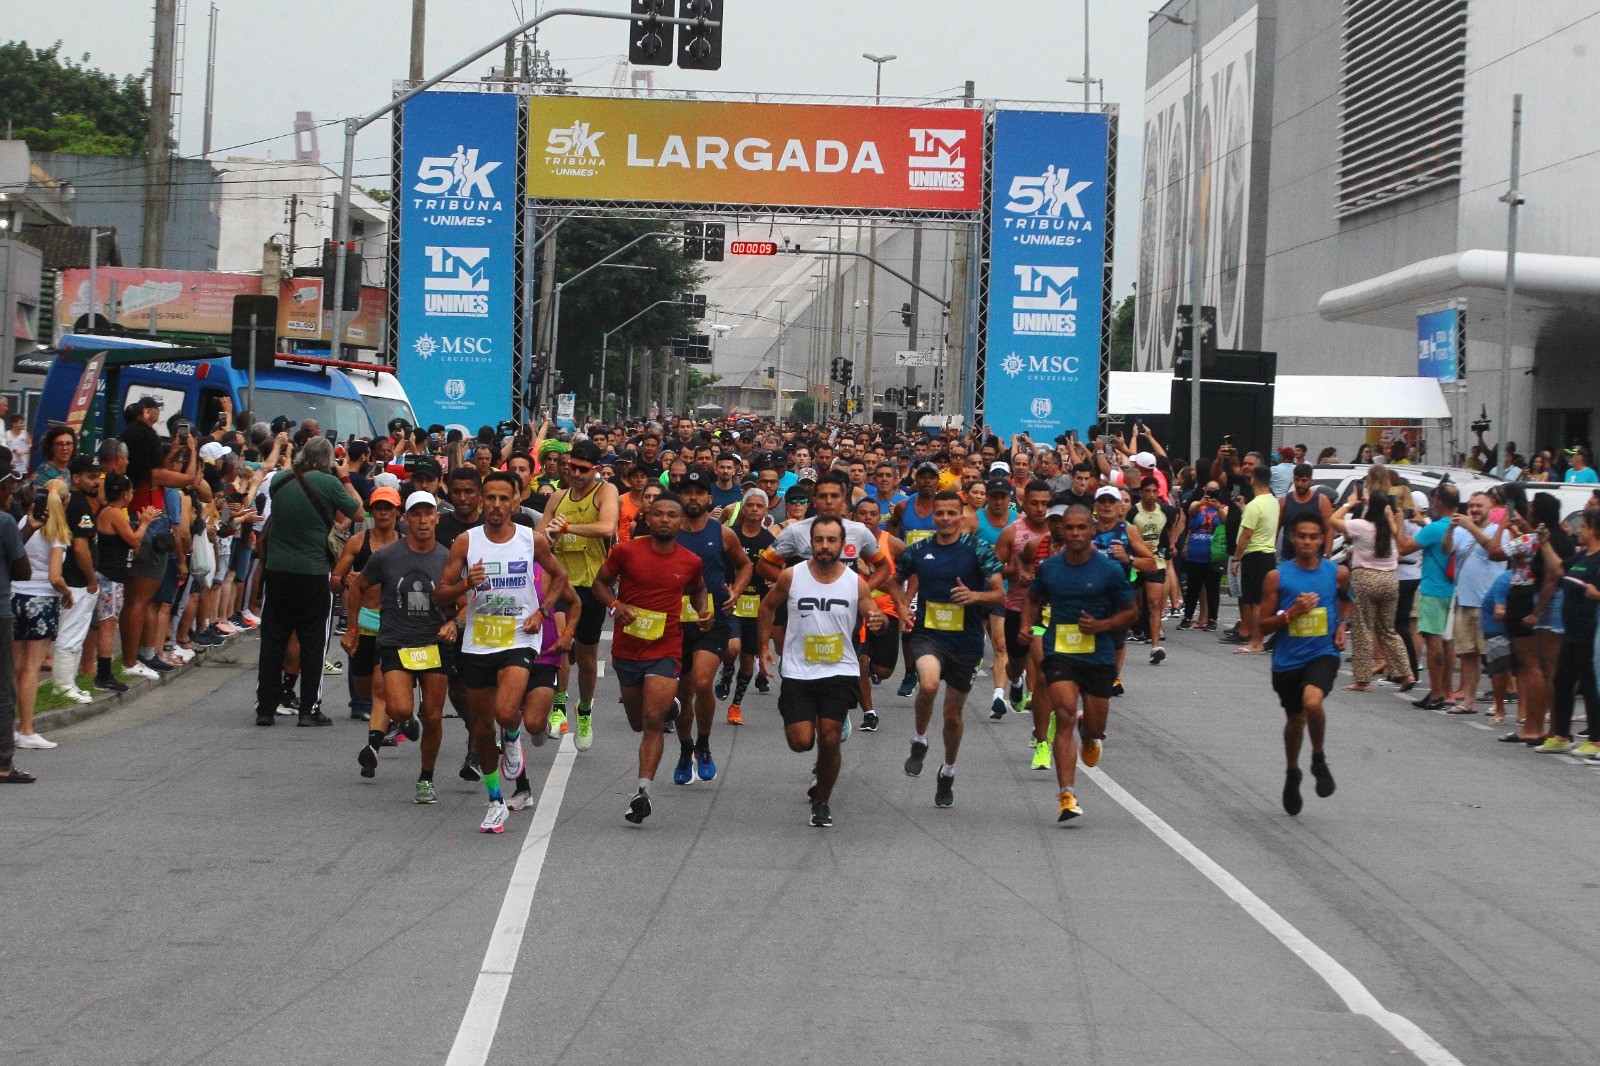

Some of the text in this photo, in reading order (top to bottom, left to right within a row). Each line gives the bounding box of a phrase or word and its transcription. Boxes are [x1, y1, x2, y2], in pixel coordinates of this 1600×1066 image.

[627, 133, 885, 174] LARGADA
[544, 157, 606, 167] TRIBUNA
[555, 168, 595, 177] UNIMES
[909, 171, 965, 189] UNIMES
[413, 199, 503, 212] TRIBUNA
[430, 215, 485, 227] UNIMES
[1003, 217, 1092, 231] TRIBUNA
[1019, 234, 1075, 247] UNIMES
[424, 293, 489, 313] UNIMES
[1012, 312, 1077, 333] UNIMES
[441, 336, 492, 354] MSC
[154, 362, 196, 376] 4020-4026
[1028, 355, 1079, 373] MSC
[1027, 374, 1079, 382] CRUZEIROS
[492, 575, 527, 588] UNIMES
[742, 601, 755, 611] 144
[636, 617, 654, 629] 527
[485, 625, 503, 637] 711
[814, 643, 835, 654] 1002
[410, 650, 428, 662] 903
